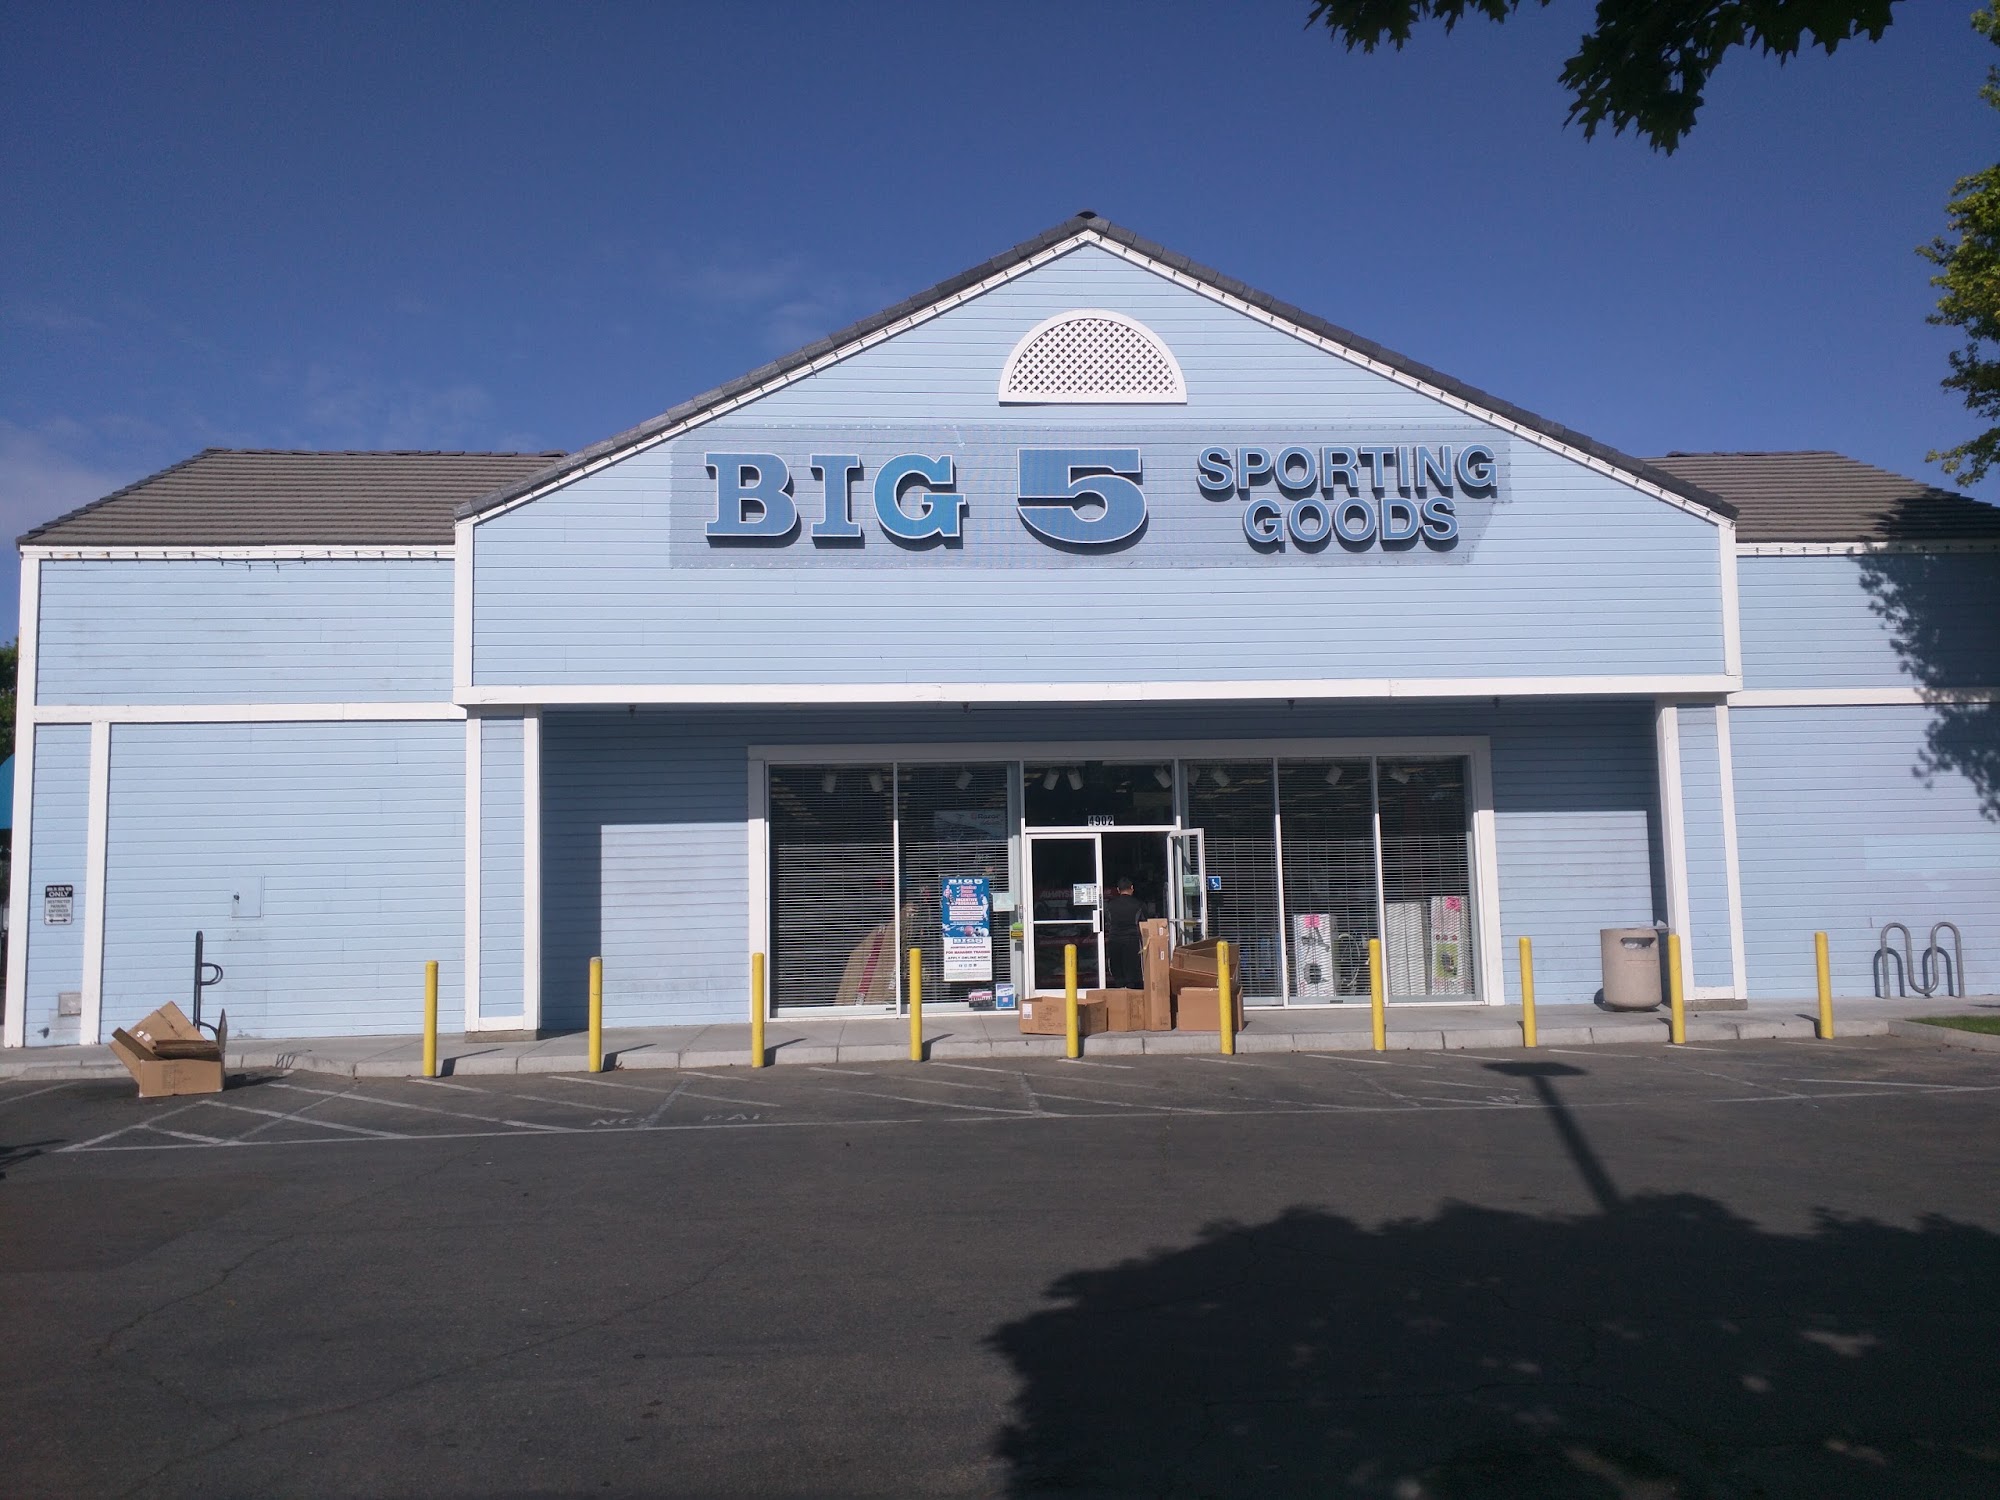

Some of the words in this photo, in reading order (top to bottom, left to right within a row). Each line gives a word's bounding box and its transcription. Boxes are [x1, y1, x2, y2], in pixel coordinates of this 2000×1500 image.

[1196, 444, 1499, 491] SPORTING
[705, 451, 967, 540] BIG
[1016, 447, 1148, 544] 5
[1243, 497, 1460, 543] GOODS
[1088, 815, 1114, 826] 4902
